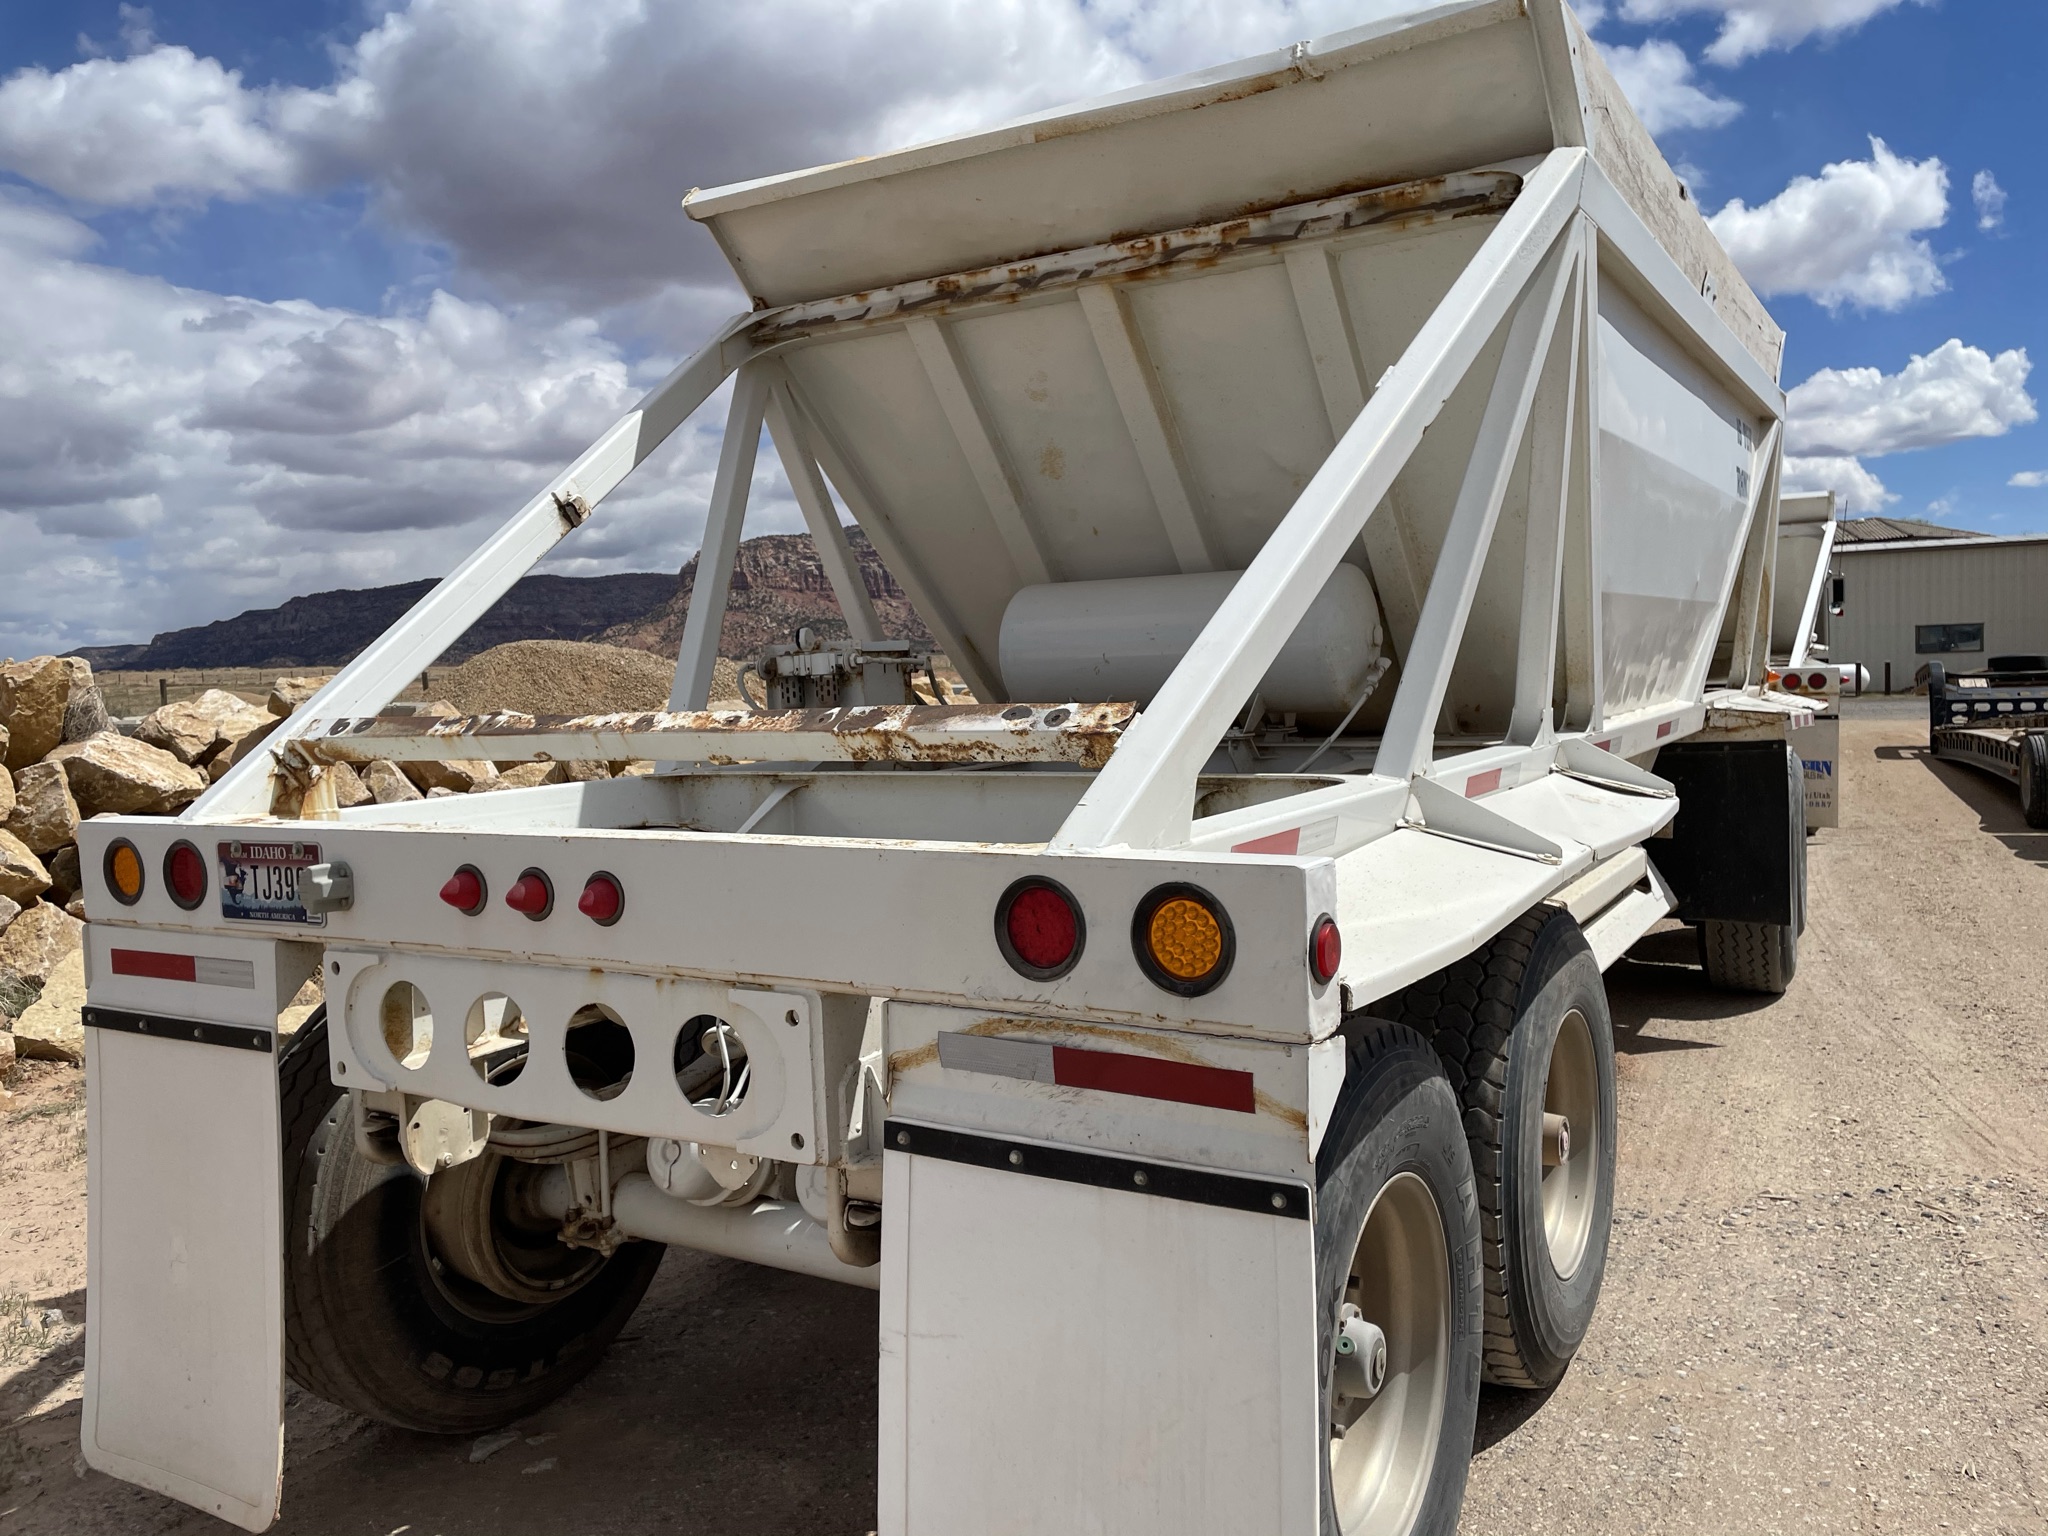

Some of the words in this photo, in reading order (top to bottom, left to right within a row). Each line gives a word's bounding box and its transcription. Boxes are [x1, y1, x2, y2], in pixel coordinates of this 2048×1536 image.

[249, 846, 286, 860] IDAHO
[249, 911, 269, 919] NORTH
[270, 912, 296, 920] AMERICA
